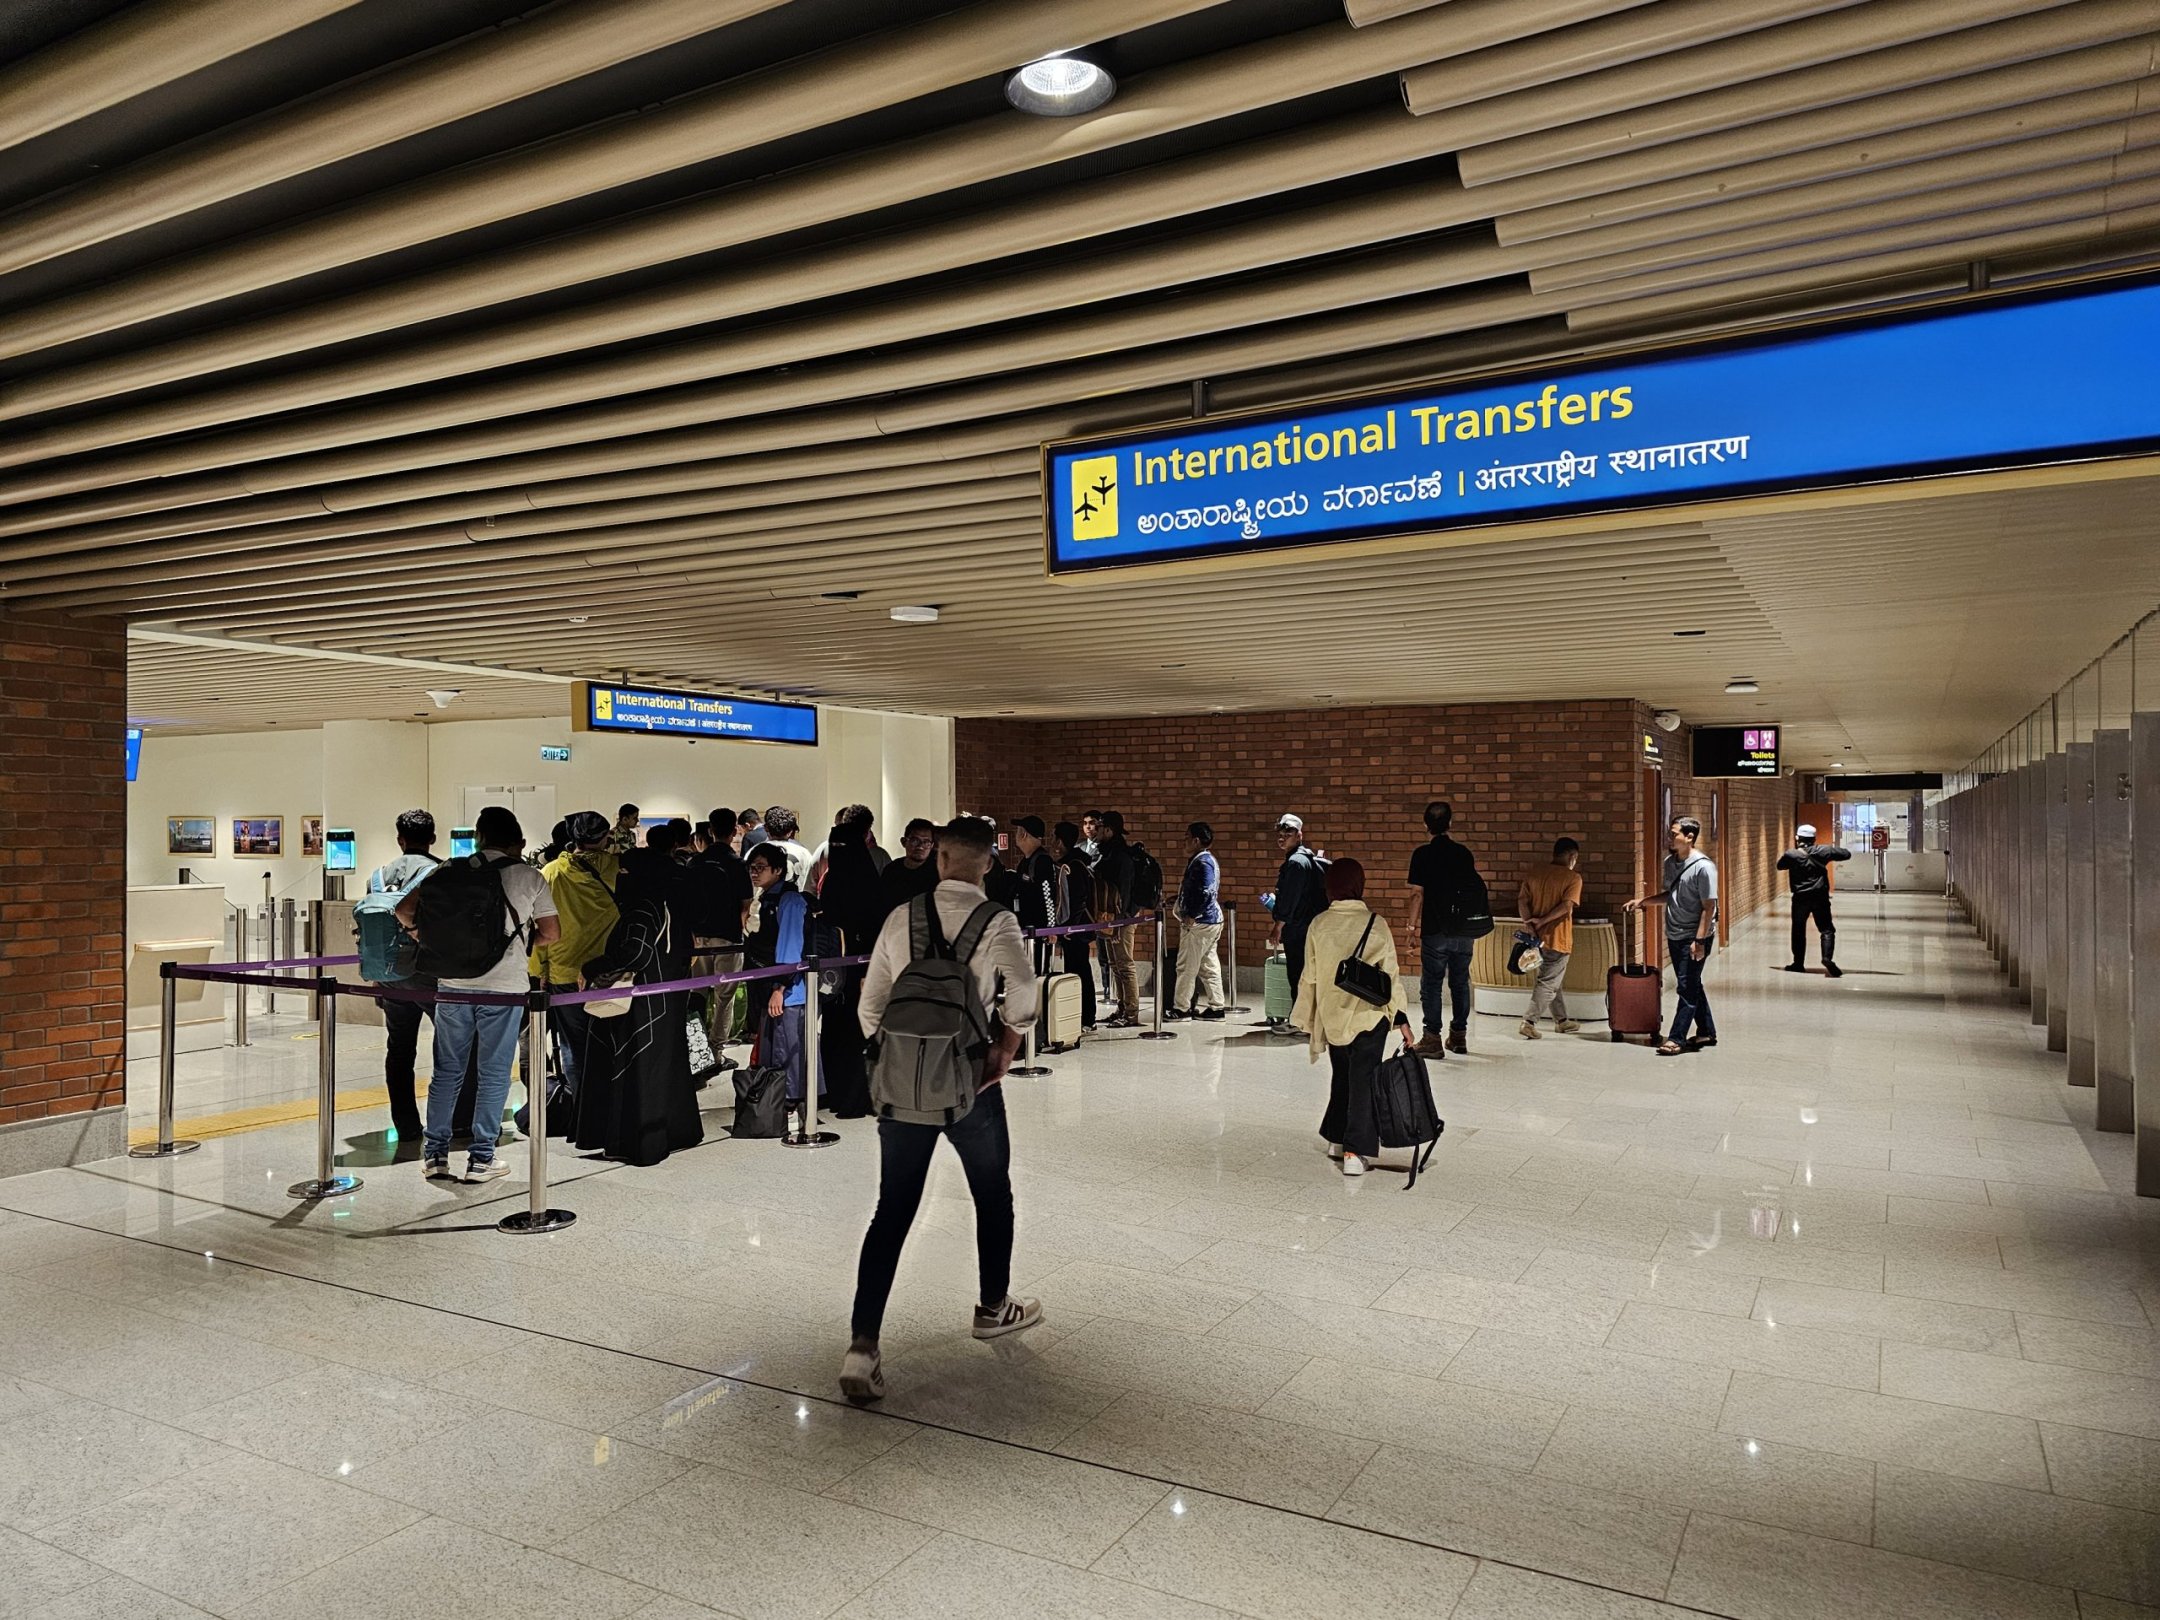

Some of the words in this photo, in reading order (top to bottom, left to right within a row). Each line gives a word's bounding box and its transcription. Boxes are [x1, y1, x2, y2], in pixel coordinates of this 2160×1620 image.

[1134, 410, 1396, 486] International
[1410, 384, 1633, 446] Transfers
[1474, 450, 1599, 491] अंतरराष्ट्रीय
[1608, 435, 1751, 475] स्थानातरण
[1137, 490, 1309, 540] ಅಂತಾರಾಷ್ಟ್ರೀಯ
[1322, 470, 1442, 512] ವರ್ಗಾವಣೆ
[615, 691, 686, 711] International
[687, 698, 733, 716] Transfers
[1750, 751, 1775, 759] Toilets
